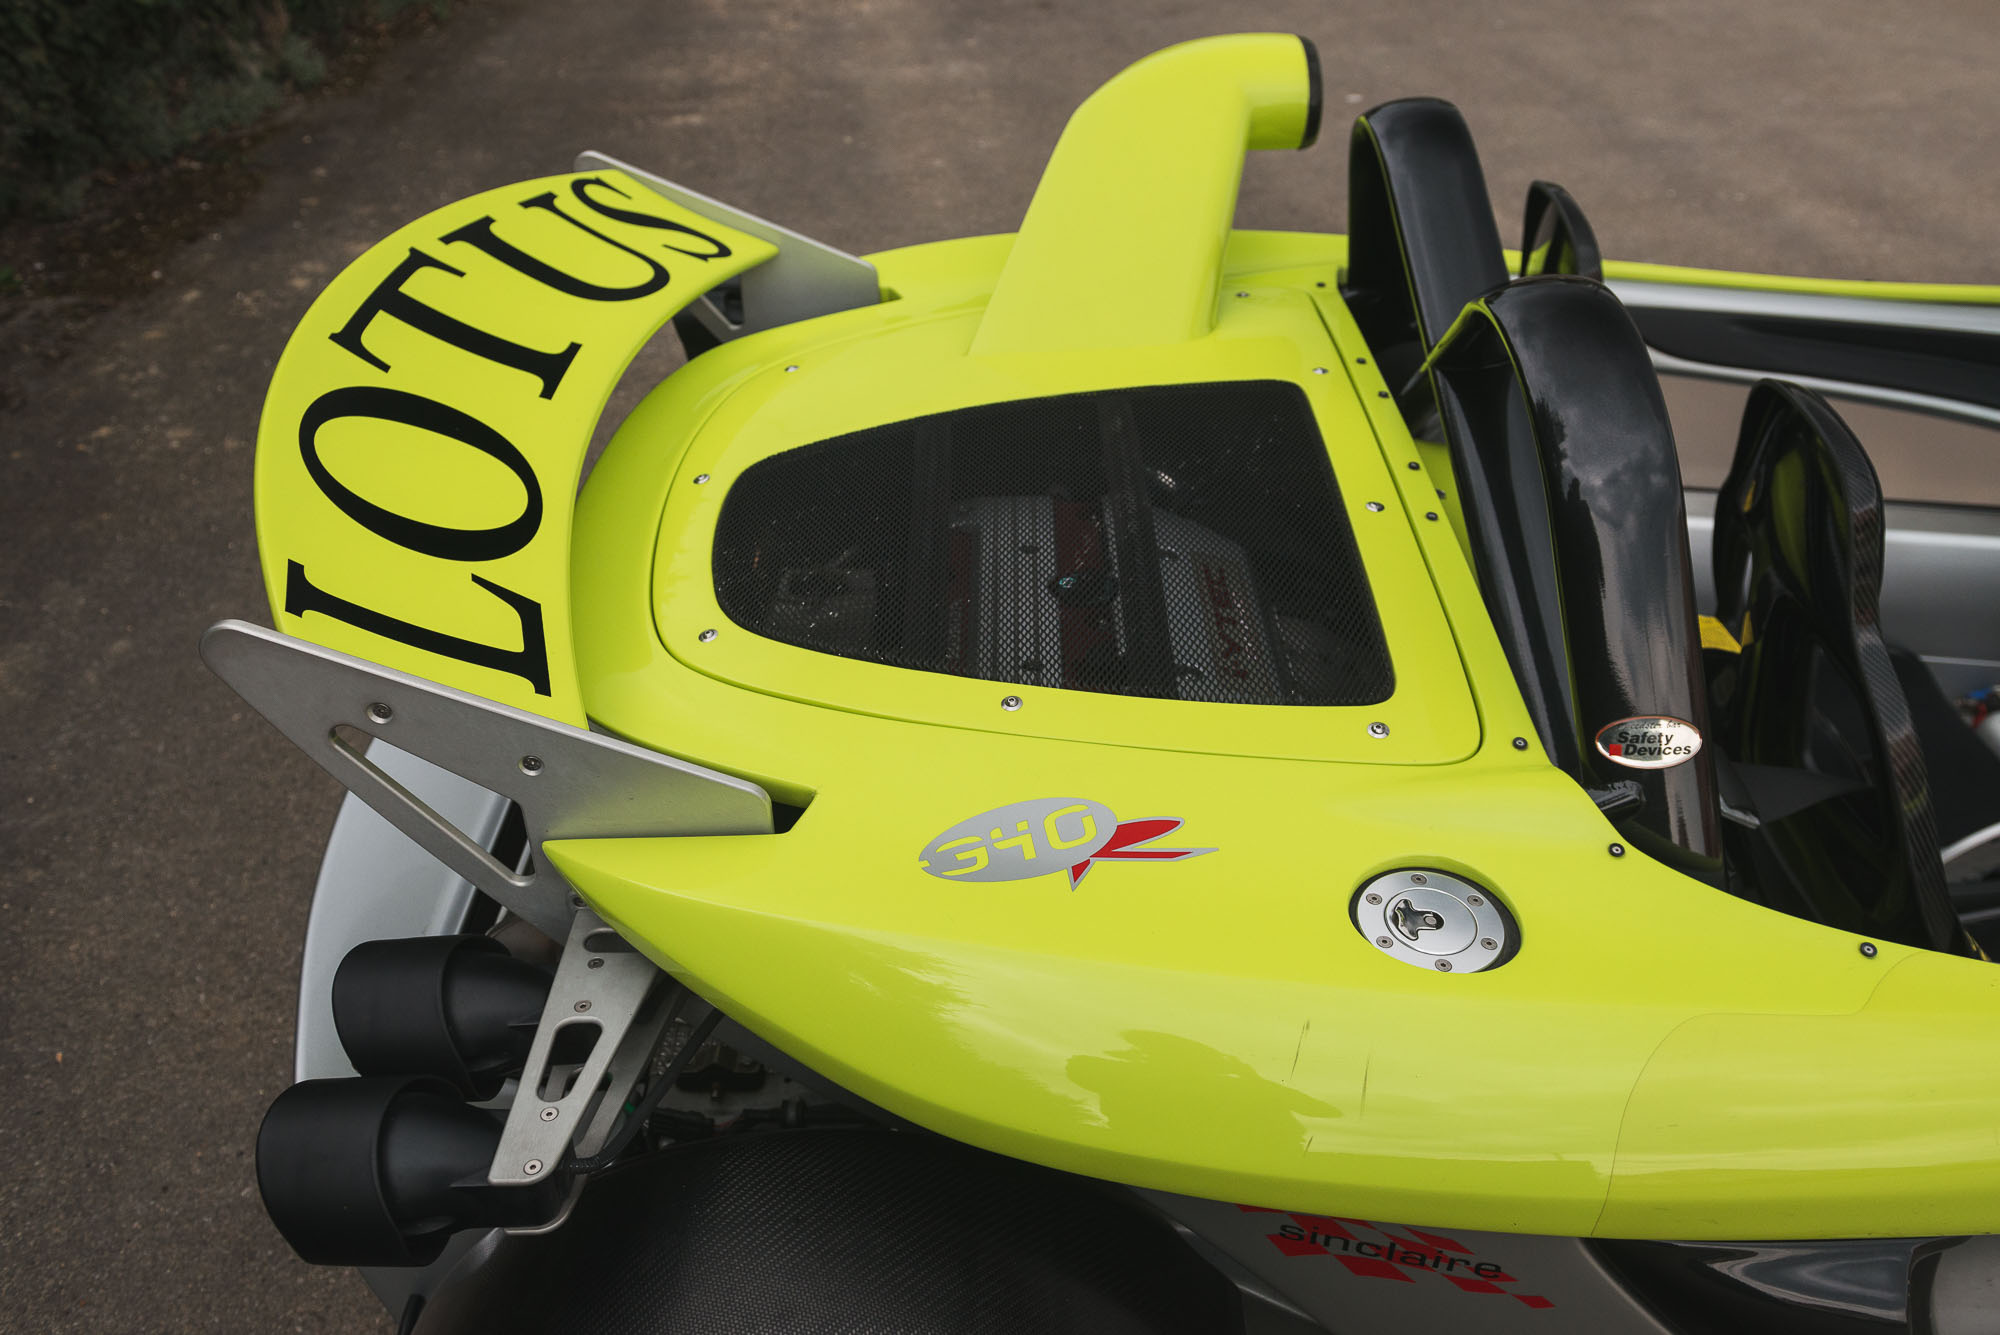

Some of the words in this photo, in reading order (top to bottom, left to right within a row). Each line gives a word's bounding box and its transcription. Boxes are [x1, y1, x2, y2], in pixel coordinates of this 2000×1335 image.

[285, 176, 733, 697] LOTUS
[1617, 731, 1674, 746] Safety
[1624, 743, 1692, 756] Devices
[1278, 1223, 1502, 1279] sinclaire
